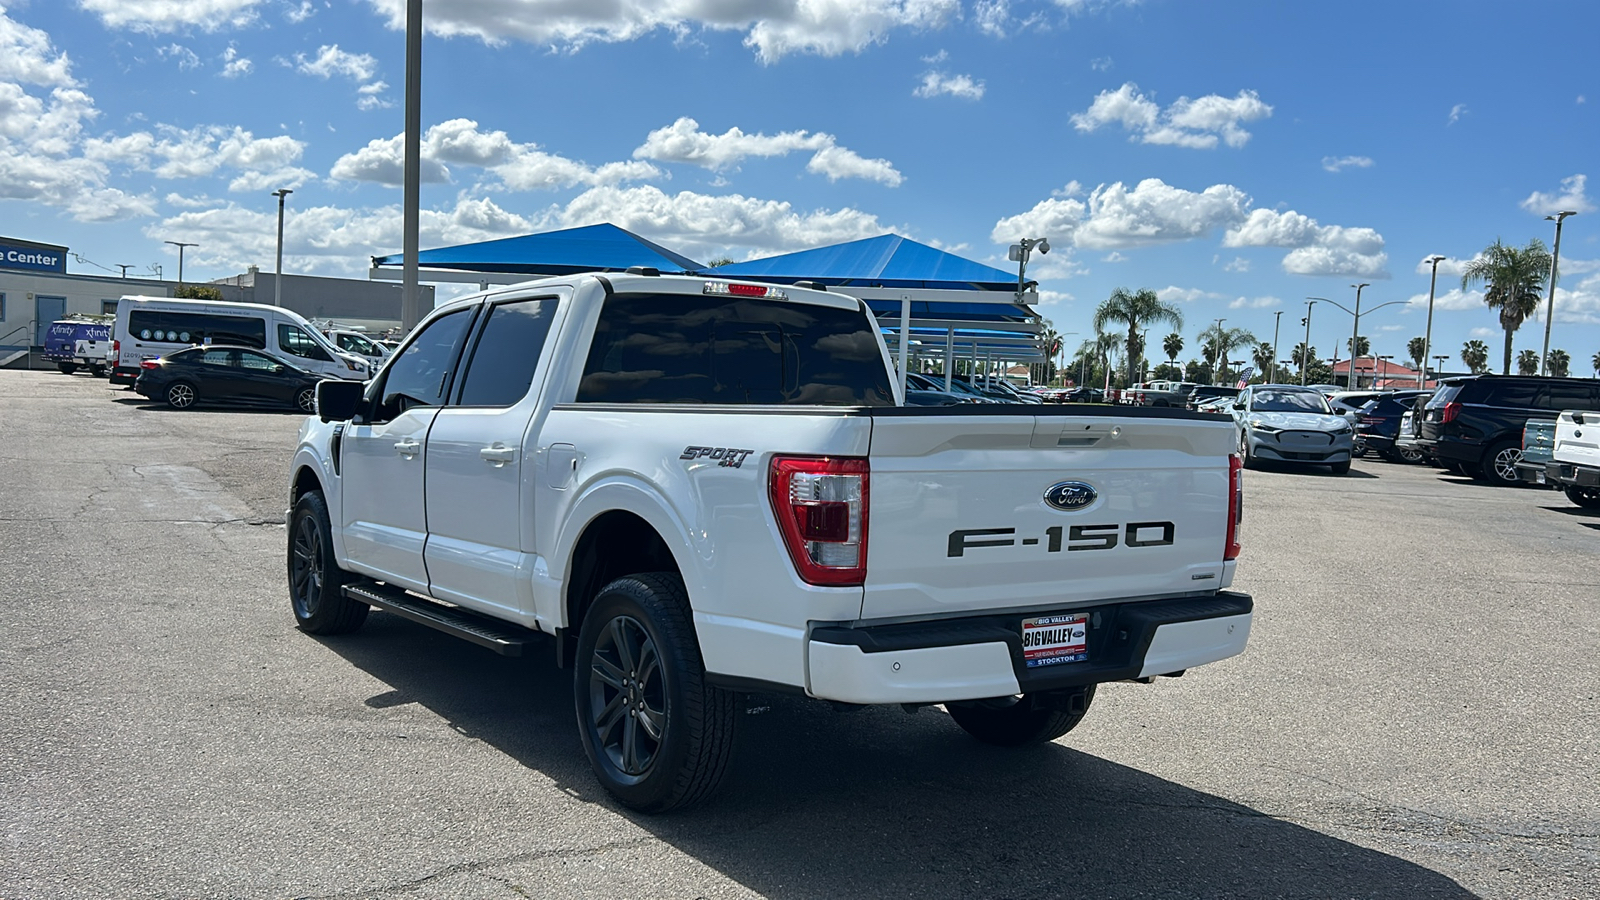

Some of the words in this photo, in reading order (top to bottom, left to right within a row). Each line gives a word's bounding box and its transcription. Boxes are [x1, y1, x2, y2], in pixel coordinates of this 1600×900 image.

[7, 251, 58, 266] Center
[51, 325, 75, 336] xfinity
[679, 445, 755, 461] SPORT
[1057, 487, 1088, 505] Ford
[947, 520, 1175, 558] F-150
[1051, 615, 1074, 623] VALLEY
[1024, 627, 1073, 647] BIGVALLEY
[1037, 655, 1075, 665] STOCKTON
